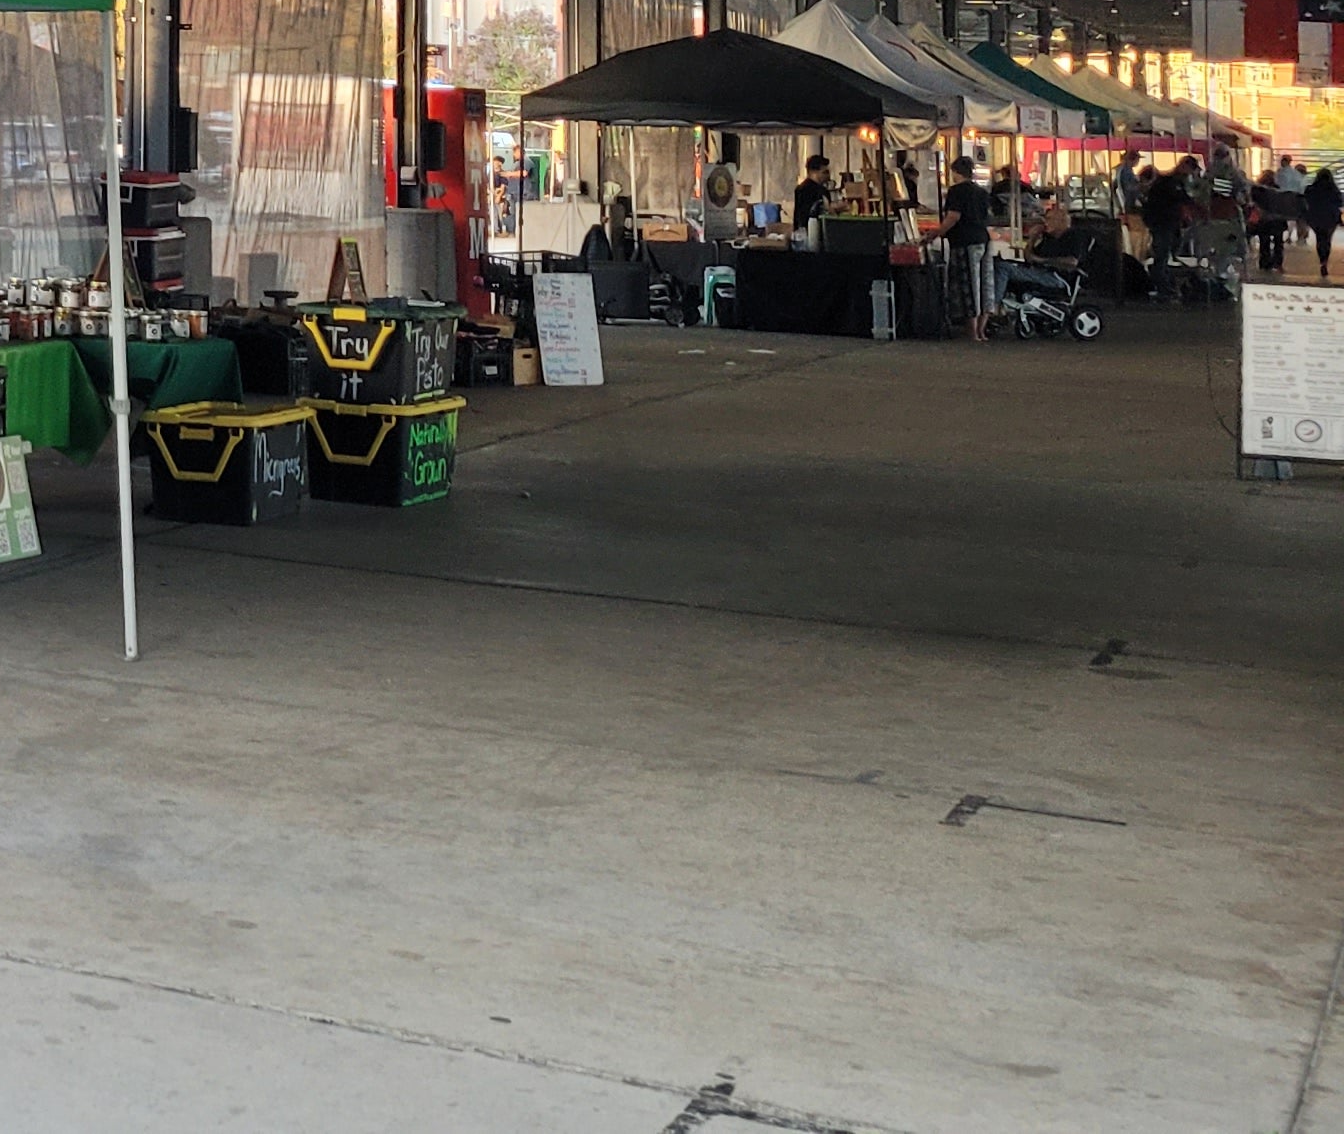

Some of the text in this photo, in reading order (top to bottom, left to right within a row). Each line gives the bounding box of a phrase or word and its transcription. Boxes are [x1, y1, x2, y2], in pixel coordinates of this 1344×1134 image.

[324, 326, 369, 360] Try
[412, 327, 431, 361] Try
[341, 370, 363, 400] it
